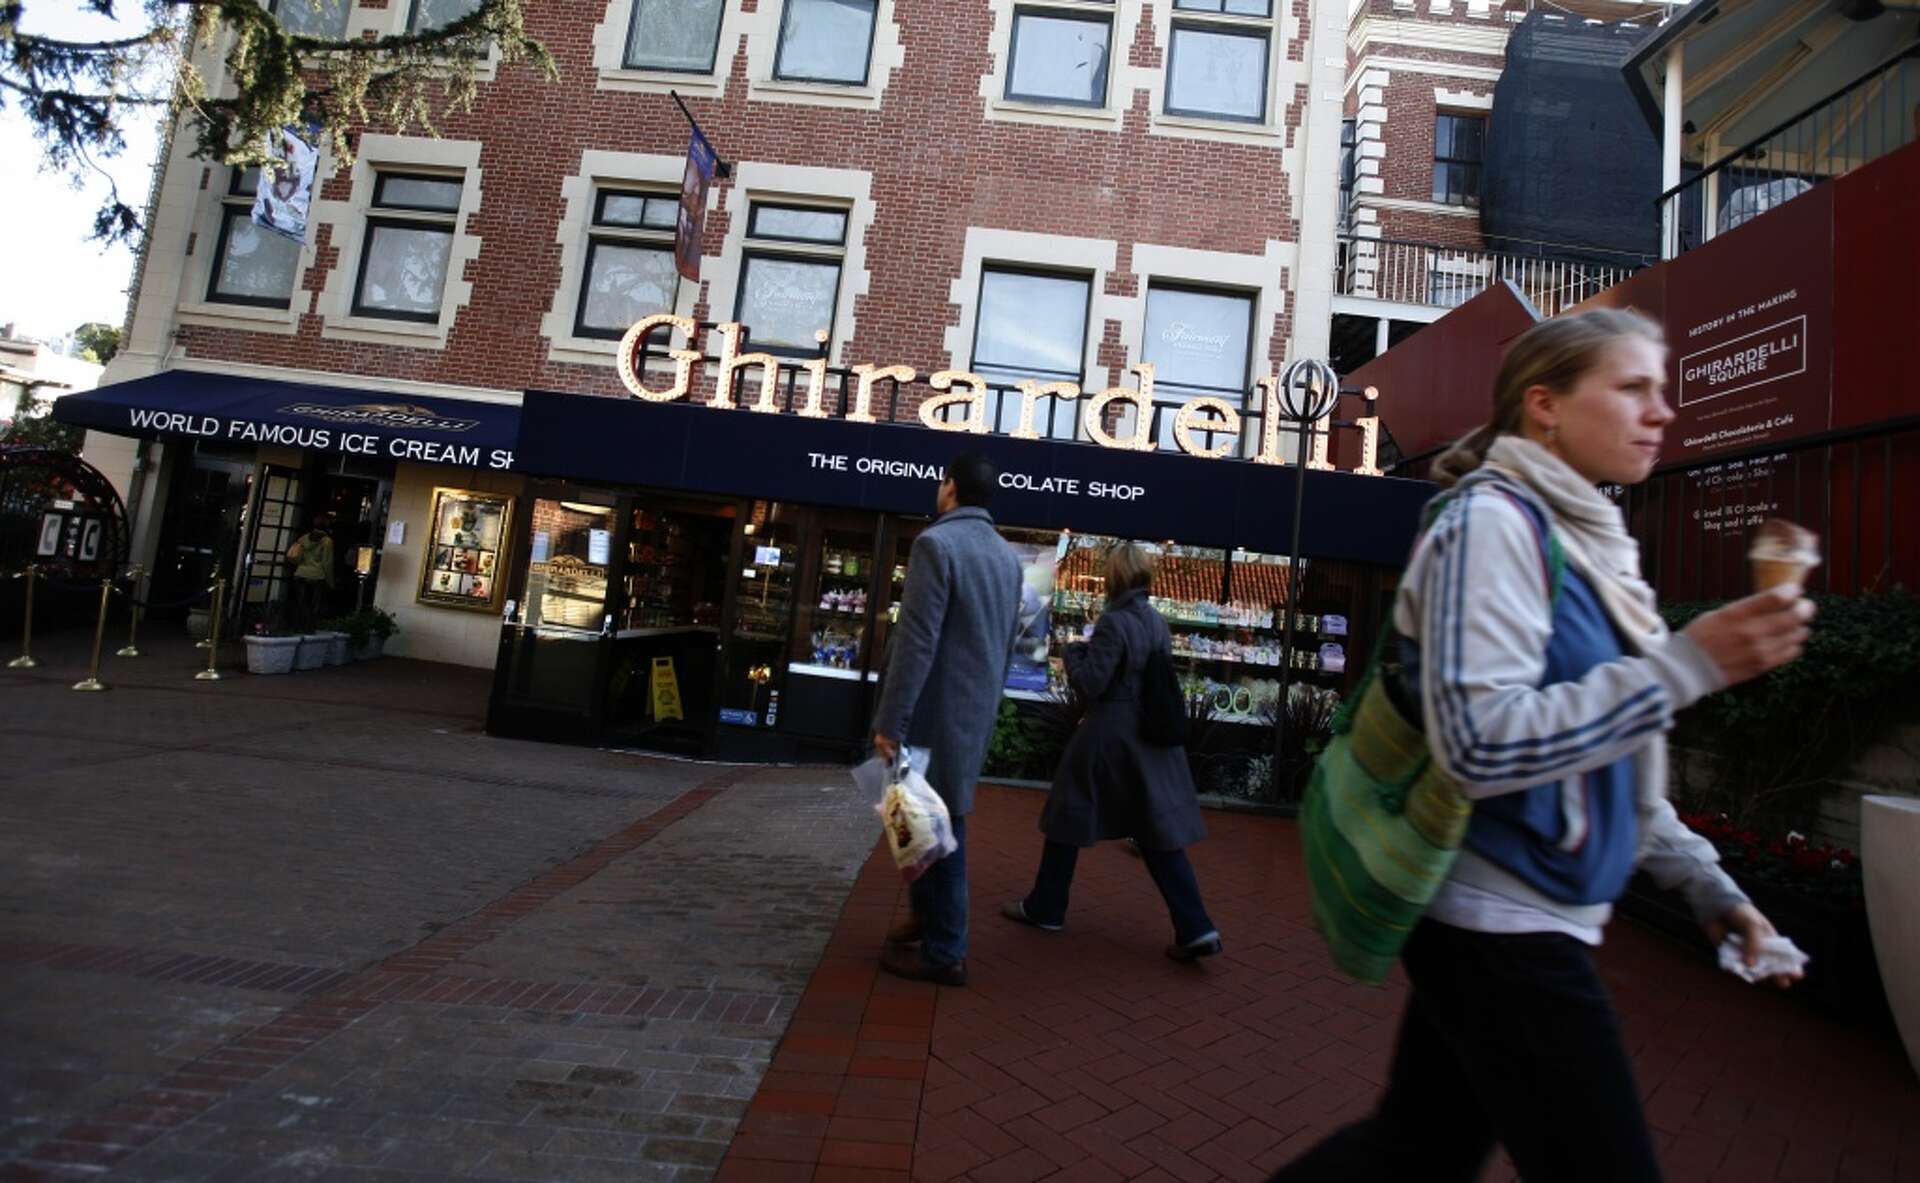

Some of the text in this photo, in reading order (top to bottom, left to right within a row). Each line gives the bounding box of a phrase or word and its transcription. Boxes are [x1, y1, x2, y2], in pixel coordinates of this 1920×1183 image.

[1688, 289, 1798, 338] HISTORY IN THE MAKING
[1685, 334, 1798, 382] GHIRARDELLI
[1708, 357, 1768, 386] SQUARE
[616, 313, 1386, 478] Ghirardelli
[130, 408, 220, 436] WORLD
[228, 420, 331, 448] FAMOUS
[339, 432, 379, 454] ICE
[389, 438, 480, 466] CREAM
[808, 453, 1145, 501] THE ORIGINAL COLATE SHOP
